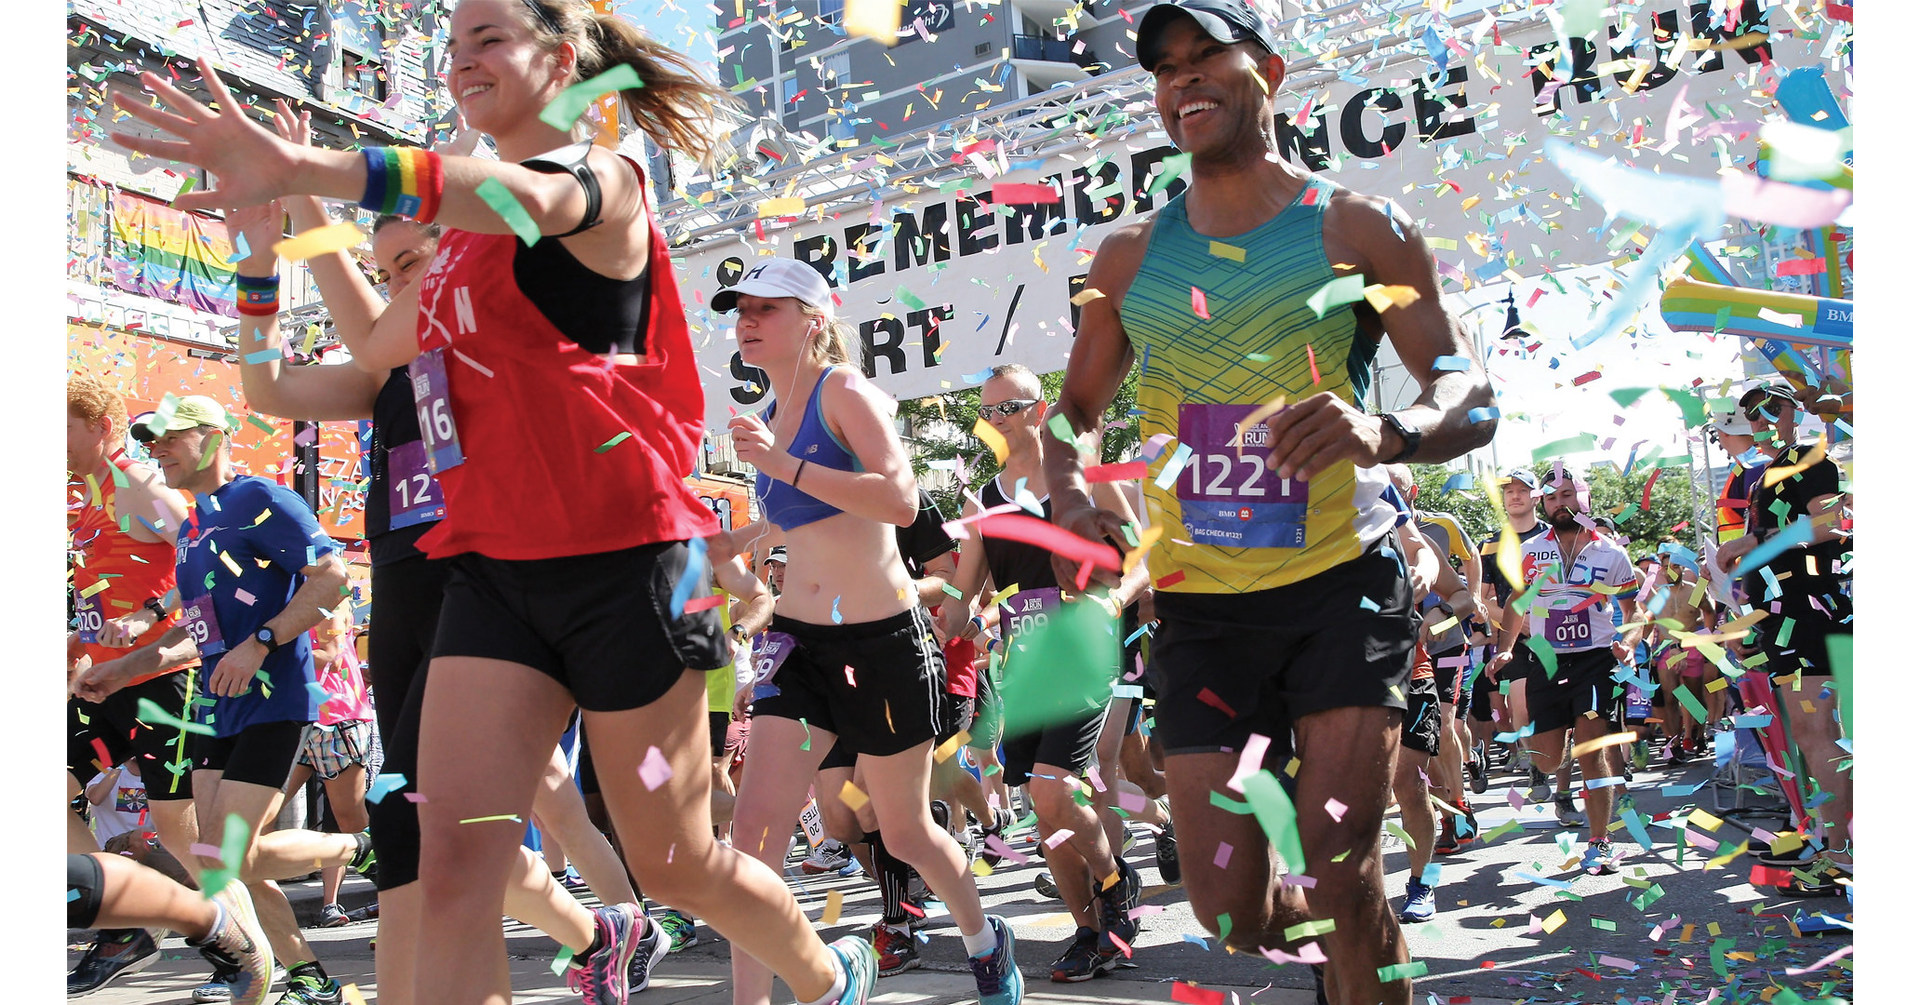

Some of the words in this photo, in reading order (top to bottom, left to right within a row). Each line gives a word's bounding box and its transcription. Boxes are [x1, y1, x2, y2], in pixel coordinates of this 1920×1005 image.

[793, 66, 1476, 289] REMEMBRNCE
[1528, 0, 1775, 117] RUN
[729, 304, 954, 405] SRT
[1218, 510, 1236, 518] BMO
[1207, 529, 1225, 538] CHECK
[1555, 623, 1589, 642] 010
